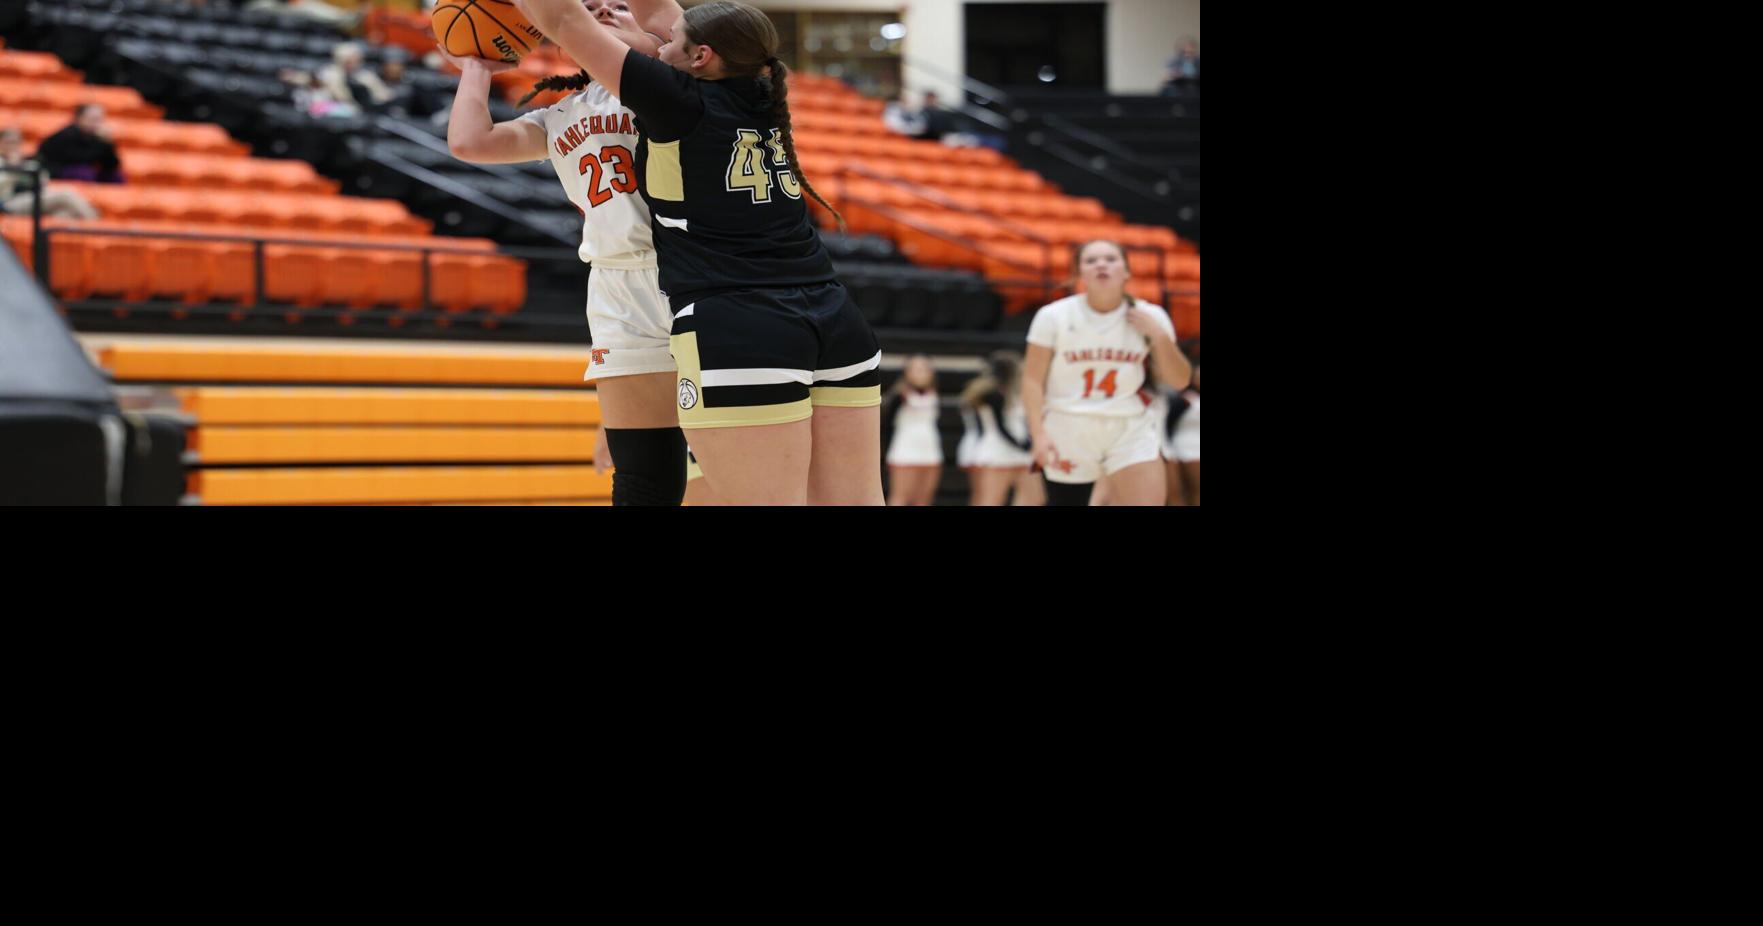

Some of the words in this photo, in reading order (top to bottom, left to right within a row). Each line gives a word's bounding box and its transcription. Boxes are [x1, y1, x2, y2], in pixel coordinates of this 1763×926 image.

[554, 113, 638, 158] AHLEQUA
[579, 145, 637, 208] 23
[726, 128, 801, 203] 45
[1082, 368, 1118, 398] 14
